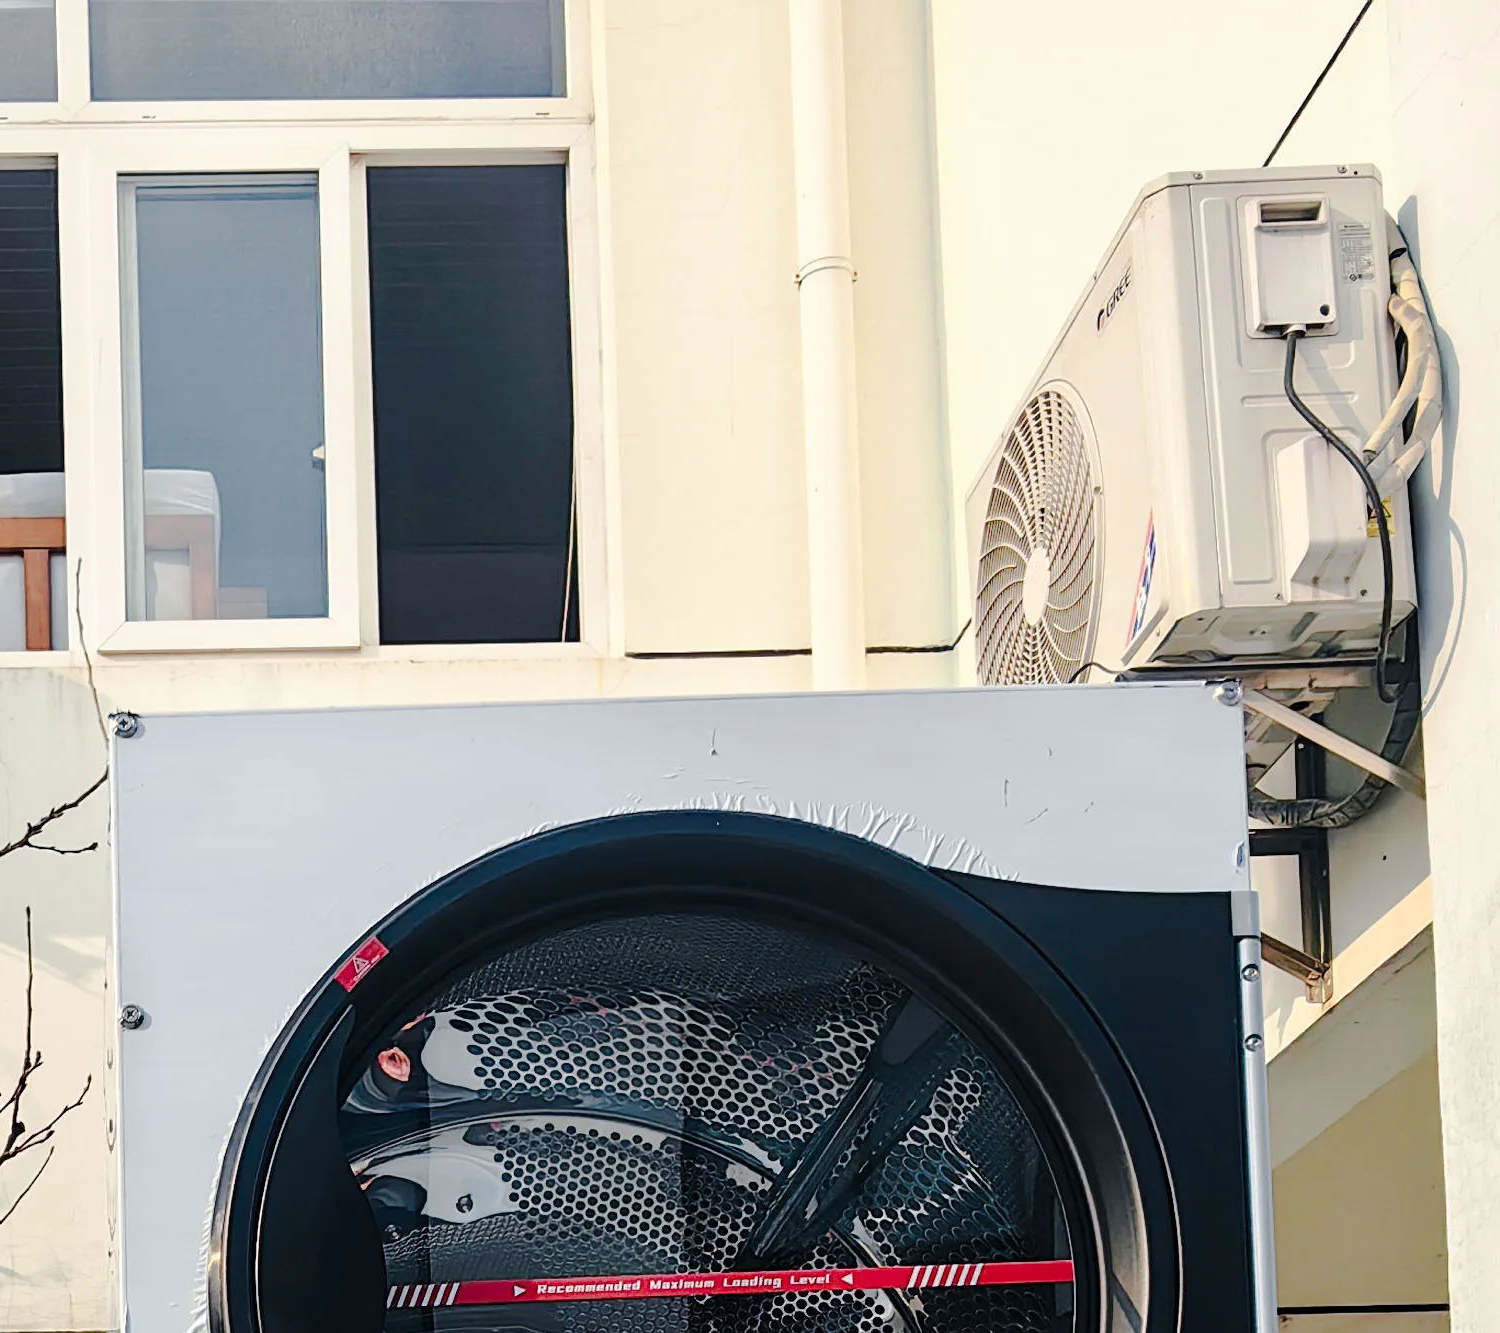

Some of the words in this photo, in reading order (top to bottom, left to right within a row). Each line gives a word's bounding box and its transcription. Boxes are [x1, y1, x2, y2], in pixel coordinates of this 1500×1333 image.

[1106, 265, 1131, 317] GREE
[536, 1279, 641, 1295] Recommended
[649, 1278, 715, 1291] Maximum
[722, 1276, 782, 1289] Loading
[789, 1274, 831, 1286] Level
